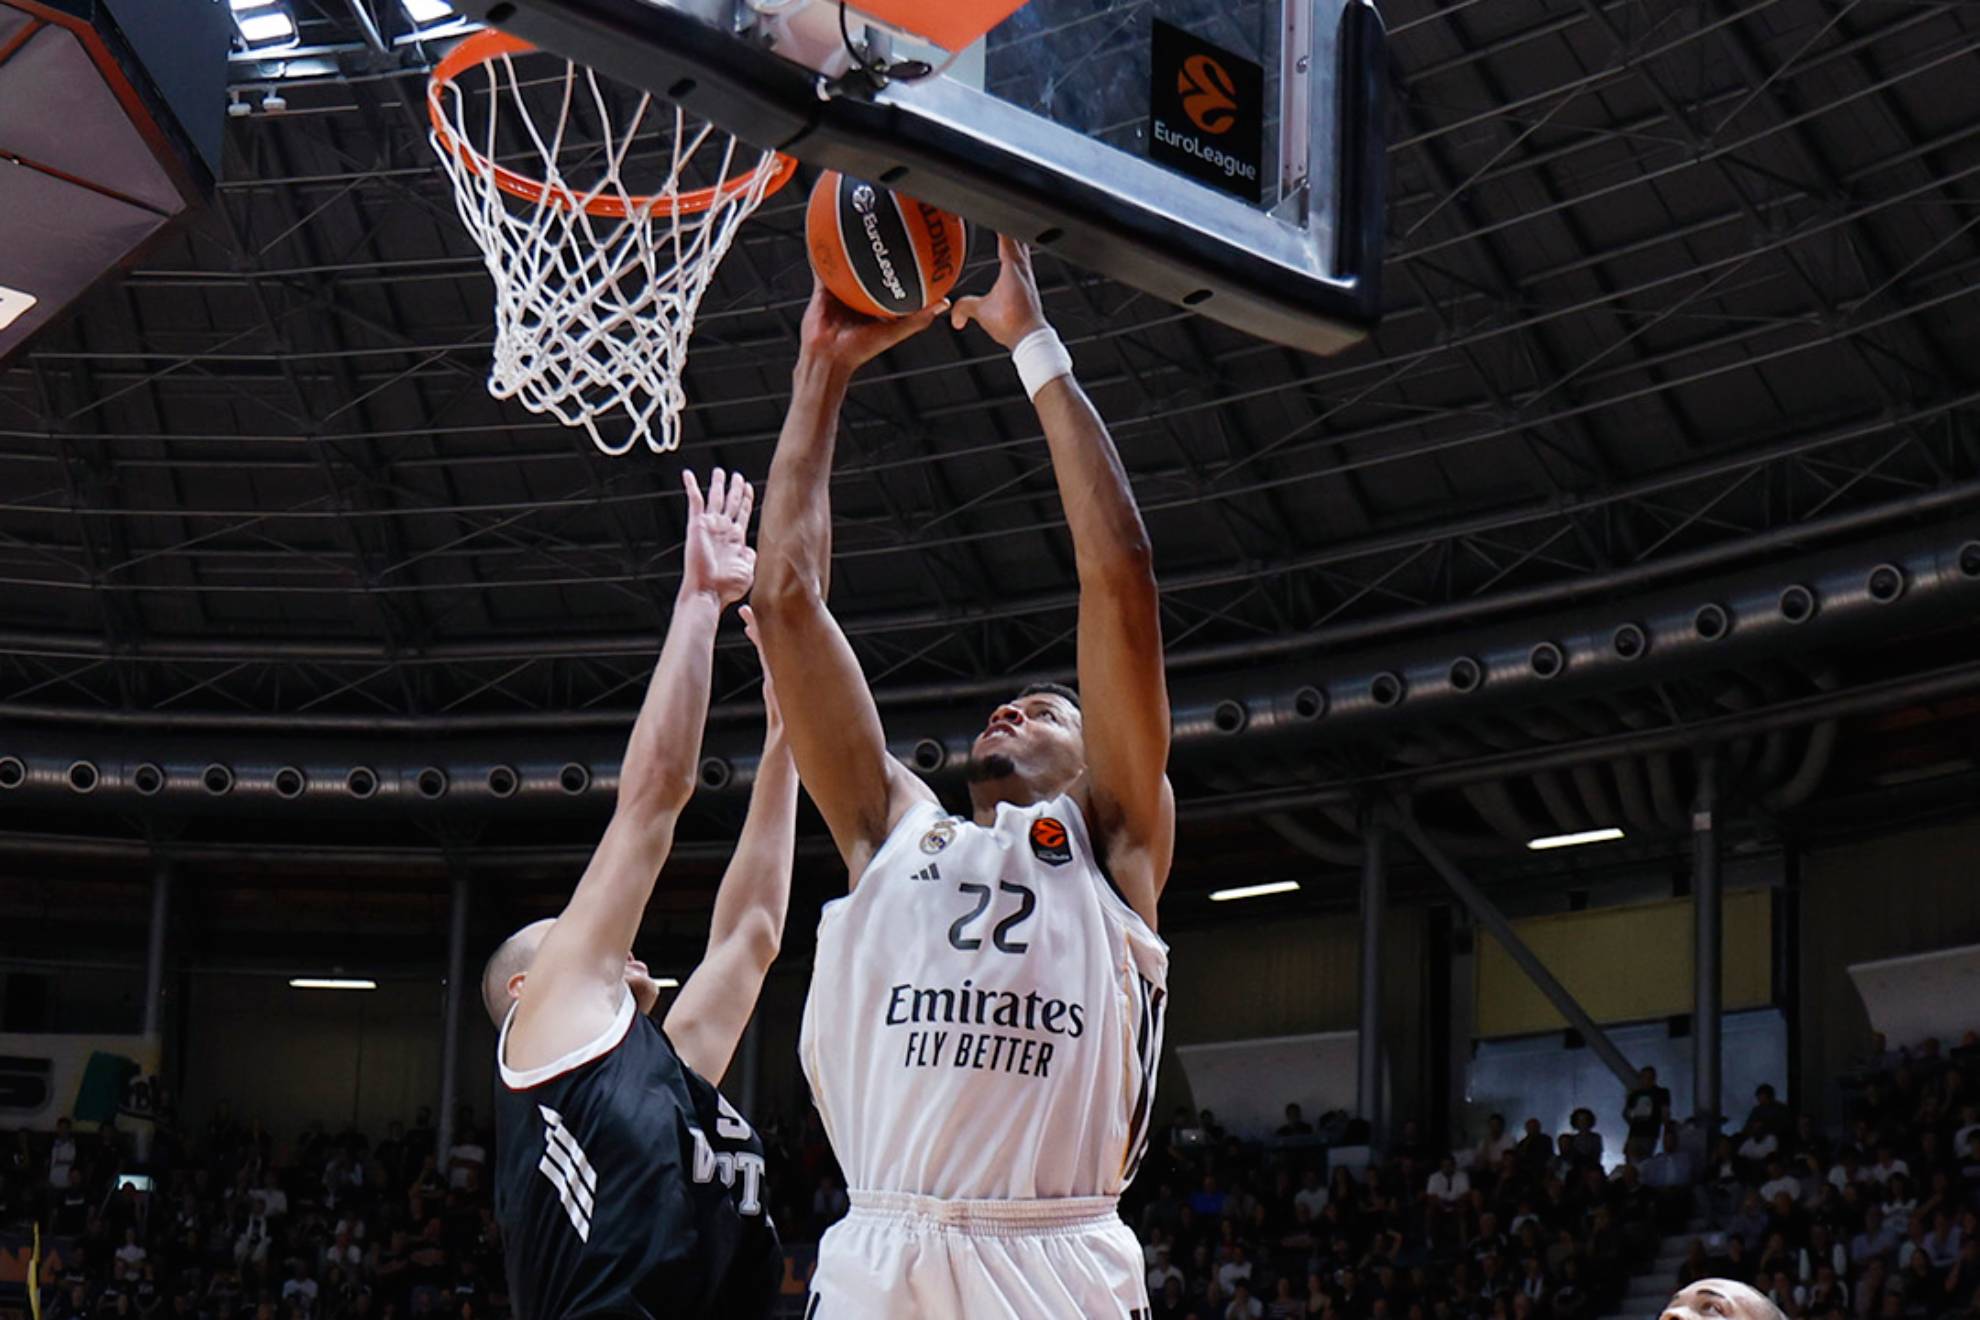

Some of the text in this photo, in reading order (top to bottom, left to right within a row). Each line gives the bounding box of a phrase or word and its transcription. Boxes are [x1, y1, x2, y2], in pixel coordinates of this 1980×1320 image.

[1153, 119, 1257, 181] EuroLeague
[862, 212, 907, 301] EuroLeague
[947, 879, 1037, 955] 22
[885, 979, 1085, 1039] Emirates
[904, 1031, 1055, 1078] FLY BETTER
